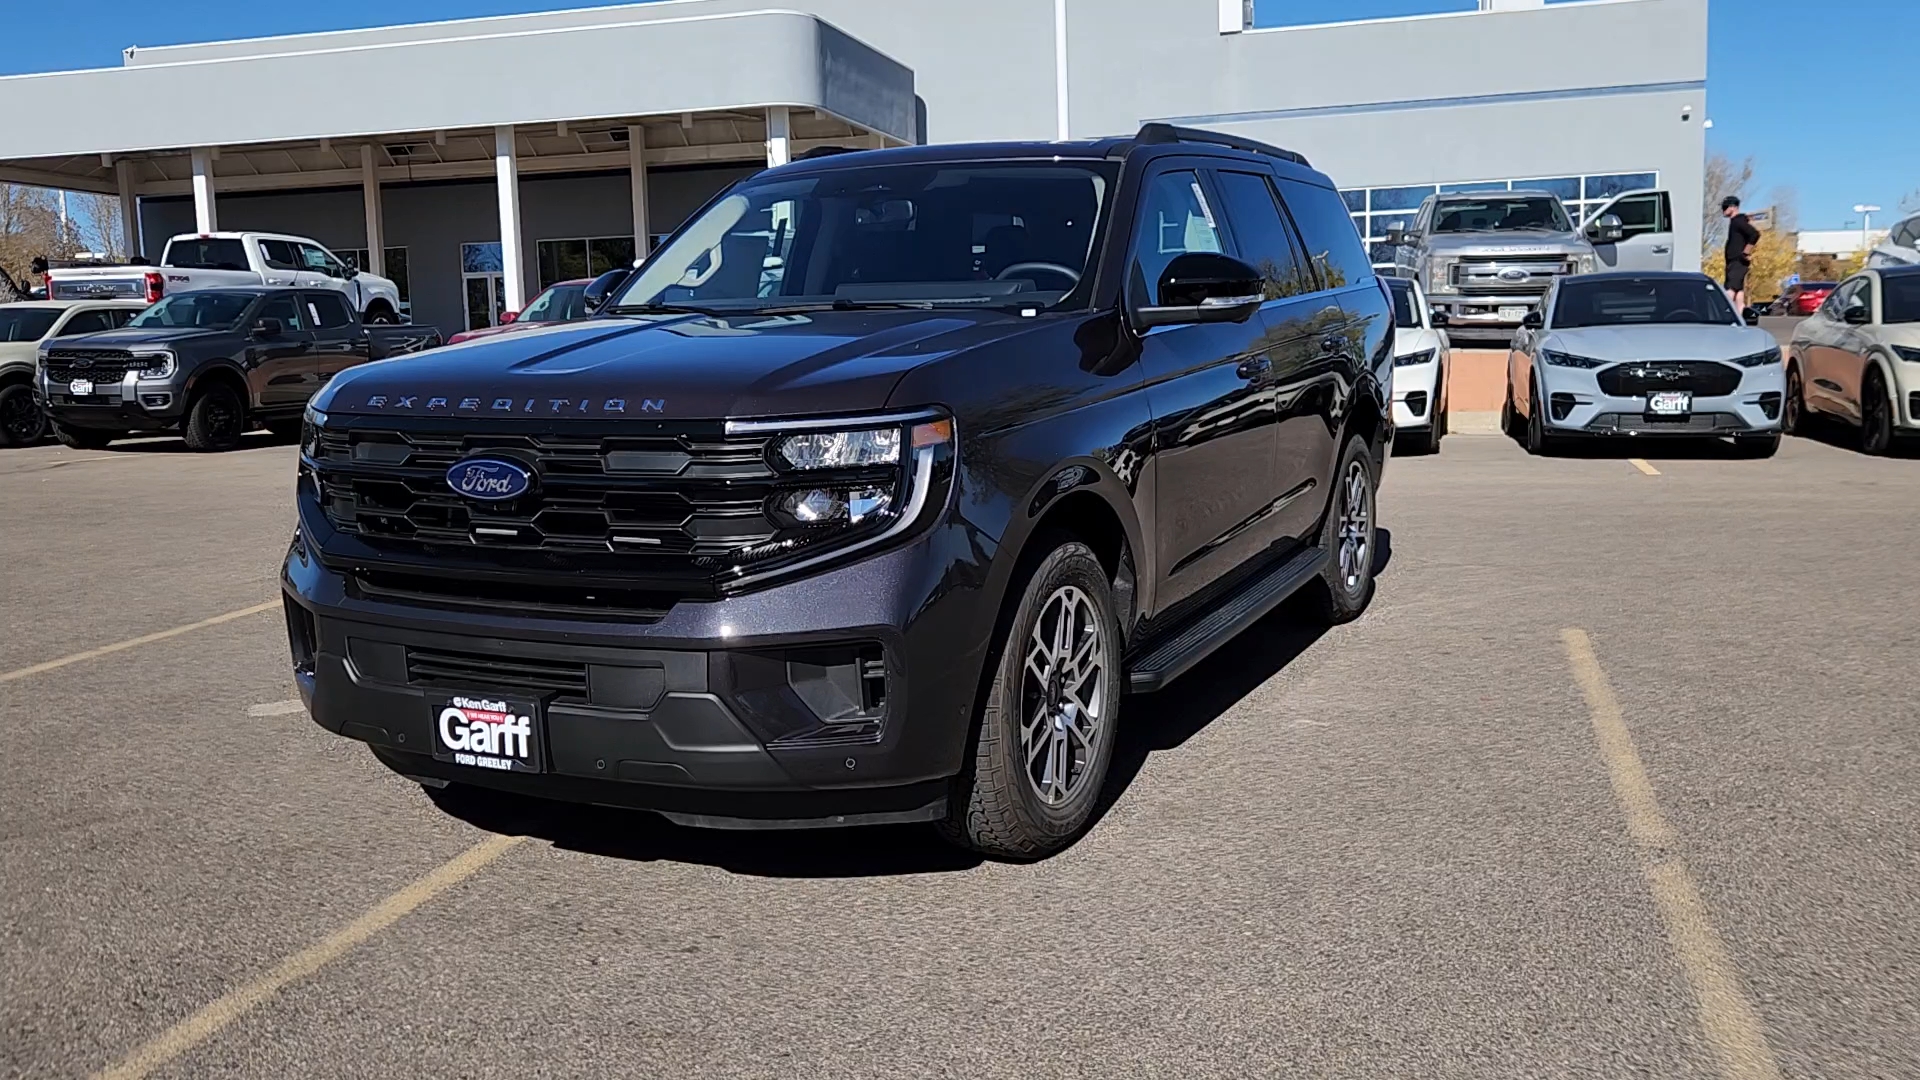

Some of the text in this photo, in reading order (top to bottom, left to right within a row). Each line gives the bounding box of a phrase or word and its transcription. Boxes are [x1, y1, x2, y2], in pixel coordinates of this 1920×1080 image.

[70, 381, 93, 393] Garff
[367, 396, 667, 413] EXPEDITION
[1650, 395, 1689, 411] Garff
[461, 466, 512, 493] Ford
[461, 697, 507, 713] Ken Garff
[439, 708, 531, 758] Garff
[455, 753, 512, 770] FORD GREELEY
